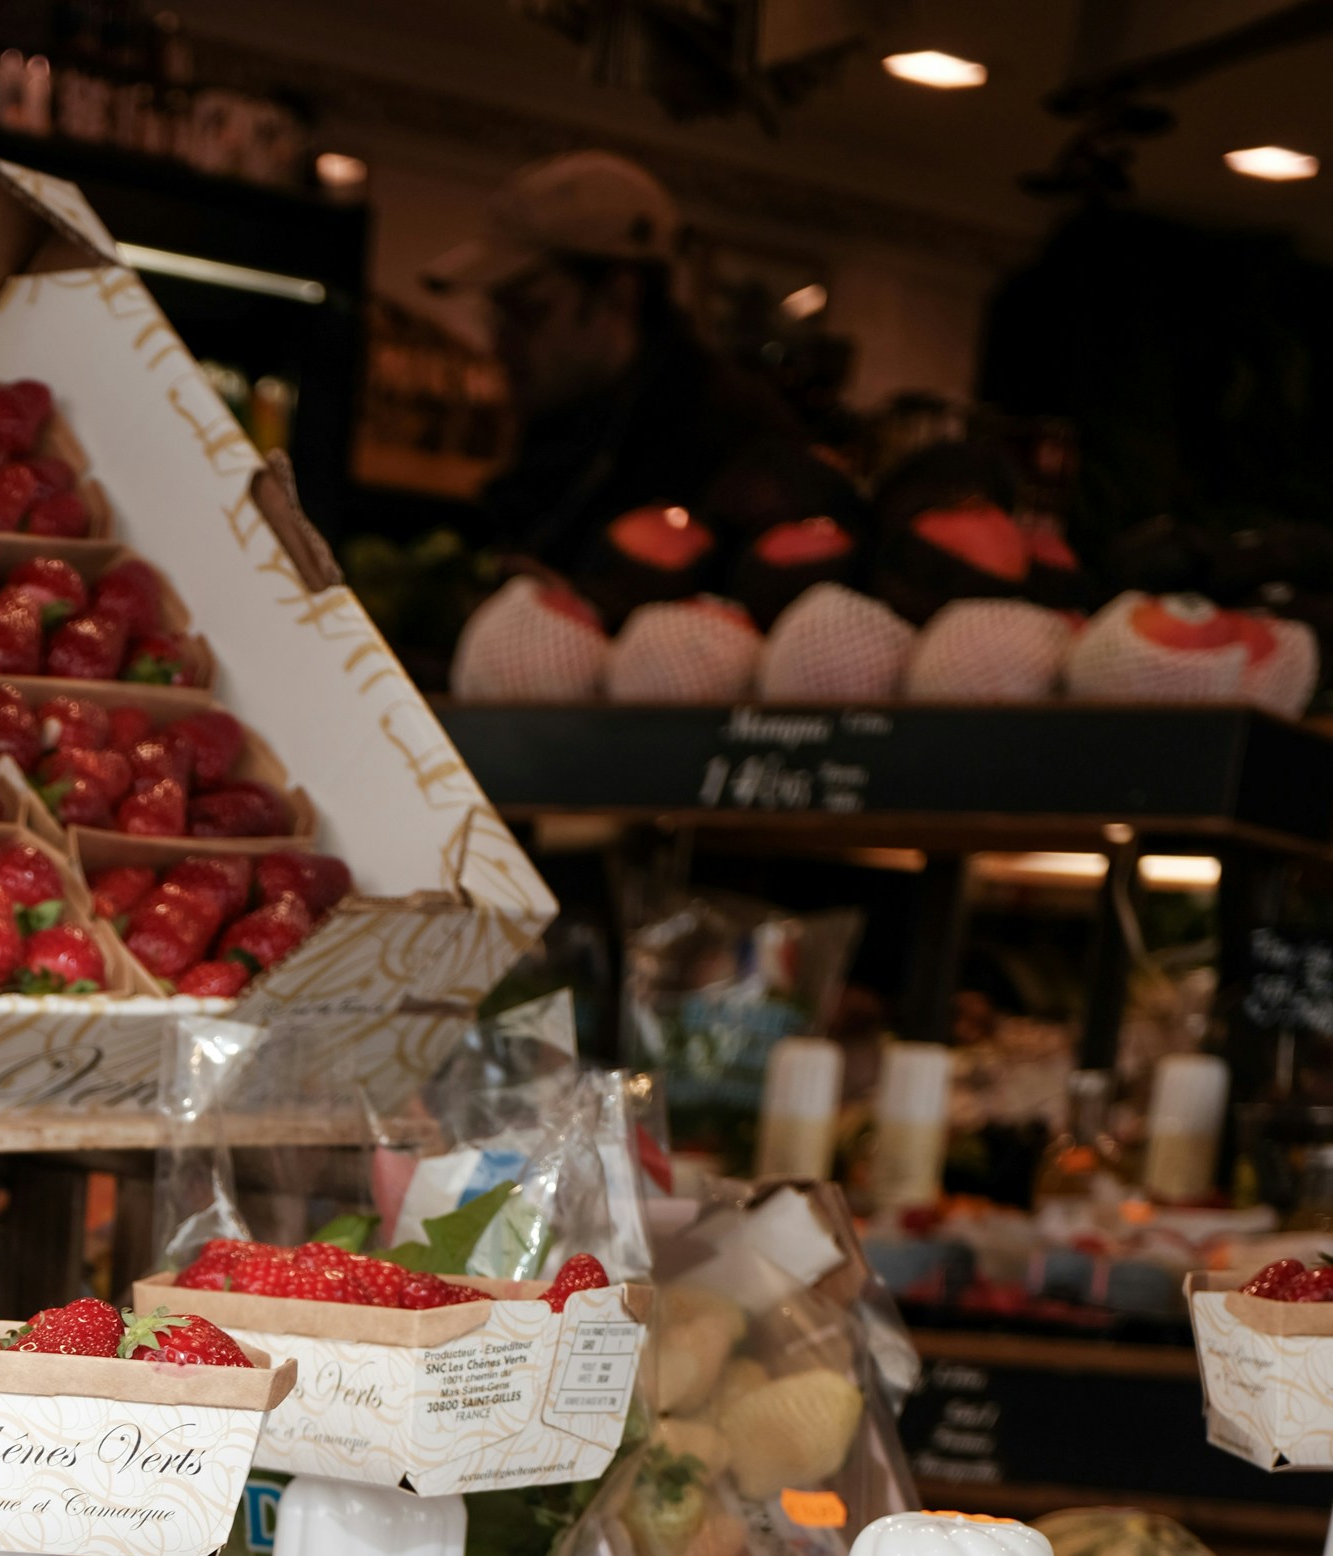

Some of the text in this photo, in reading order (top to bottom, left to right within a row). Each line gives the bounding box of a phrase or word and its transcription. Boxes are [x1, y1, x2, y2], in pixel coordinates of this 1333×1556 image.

[424, 1349, 476, 1361] Producteur
[425, 1354, 527, 1375] SNC Les Verts
[315, 1359, 382, 1410] Verts
[440, 1385, 460, 1397] Mas
[427, 1400, 459, 1414] 30800
[455, 1408, 491, 1422] FRANCE
[97, 1421, 205, 1477] Verts
[32, 1497, 50, 1514] et
[60, 1489, 177, 1529] Camargue
